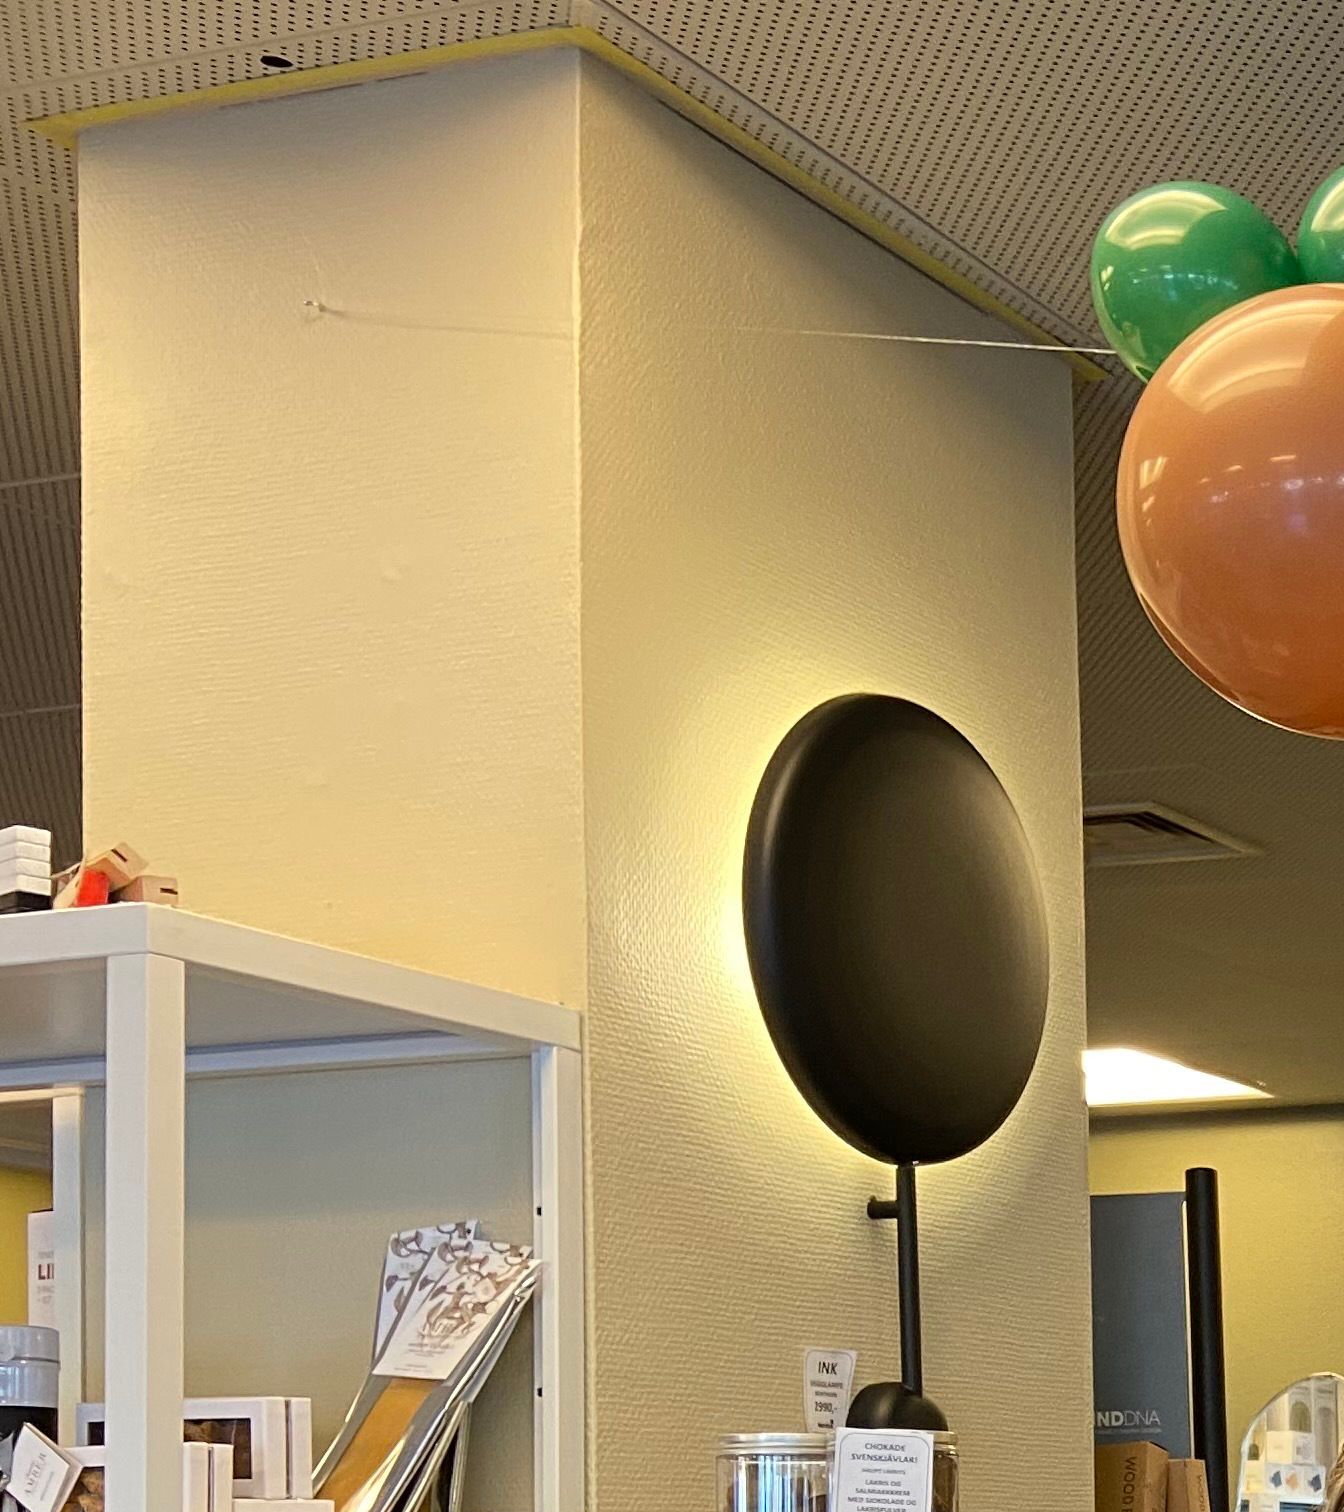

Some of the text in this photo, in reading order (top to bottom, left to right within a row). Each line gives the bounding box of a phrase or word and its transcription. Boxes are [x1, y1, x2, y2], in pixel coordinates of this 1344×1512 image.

[817, 1360, 838, 1375] INK
[1097, 1409, 1161, 1427] NDDNA
[1123, 1456, 1138, 1505] WOOD
